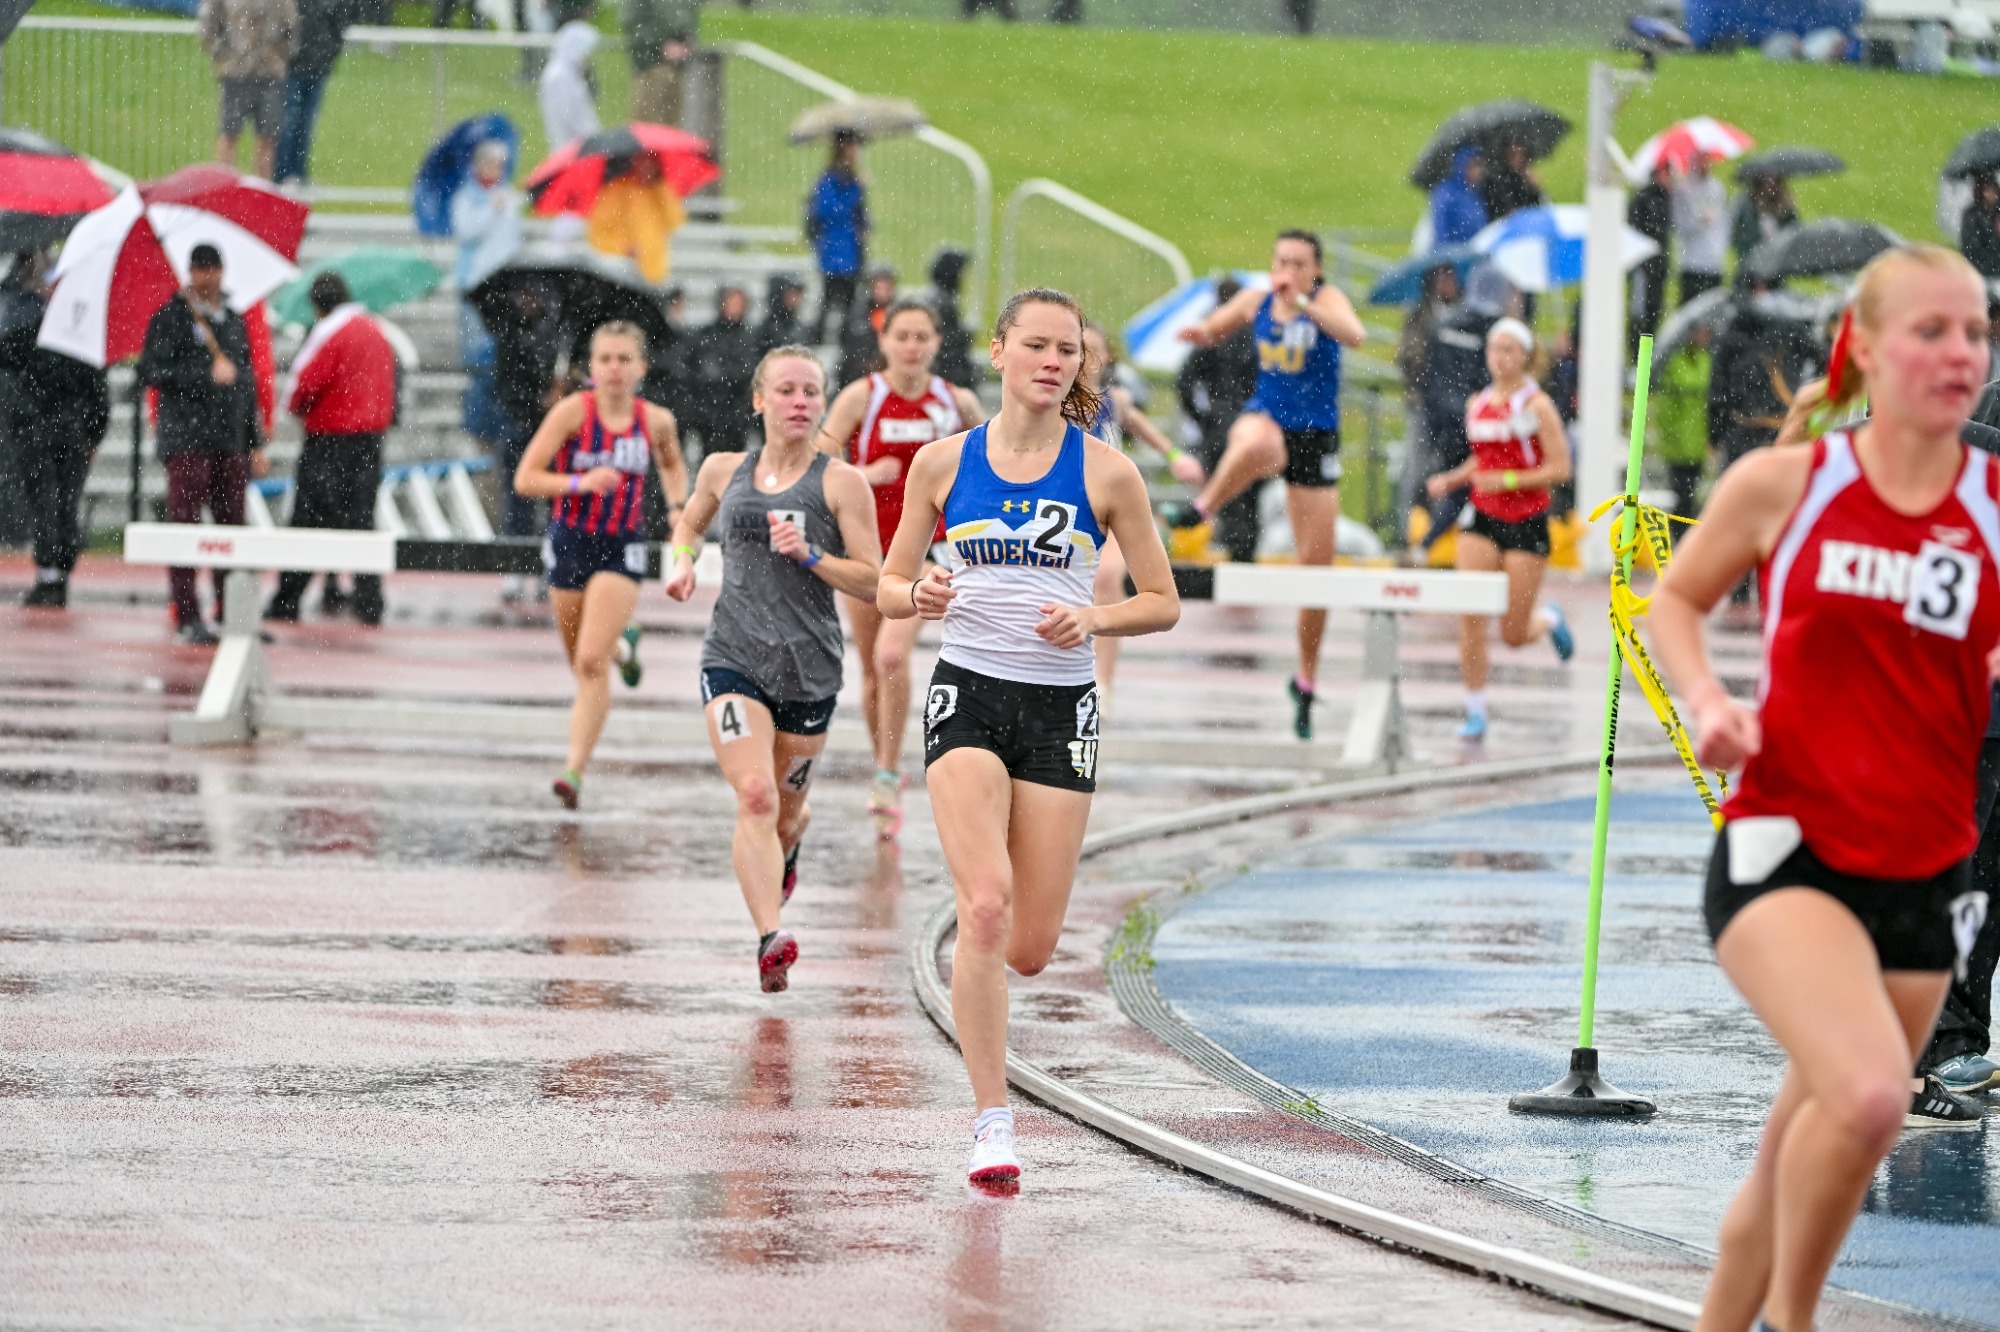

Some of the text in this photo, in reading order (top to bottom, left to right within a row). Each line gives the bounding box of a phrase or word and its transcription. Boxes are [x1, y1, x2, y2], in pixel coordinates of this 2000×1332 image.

[1033, 505, 1069, 553] 2
[1815, 539, 1918, 604] KIN
[1919, 556, 1963, 620] 3
[722, 700, 741, 736] 4
[1080, 691, 1097, 737] 2
[787, 758, 813, 791] 4
